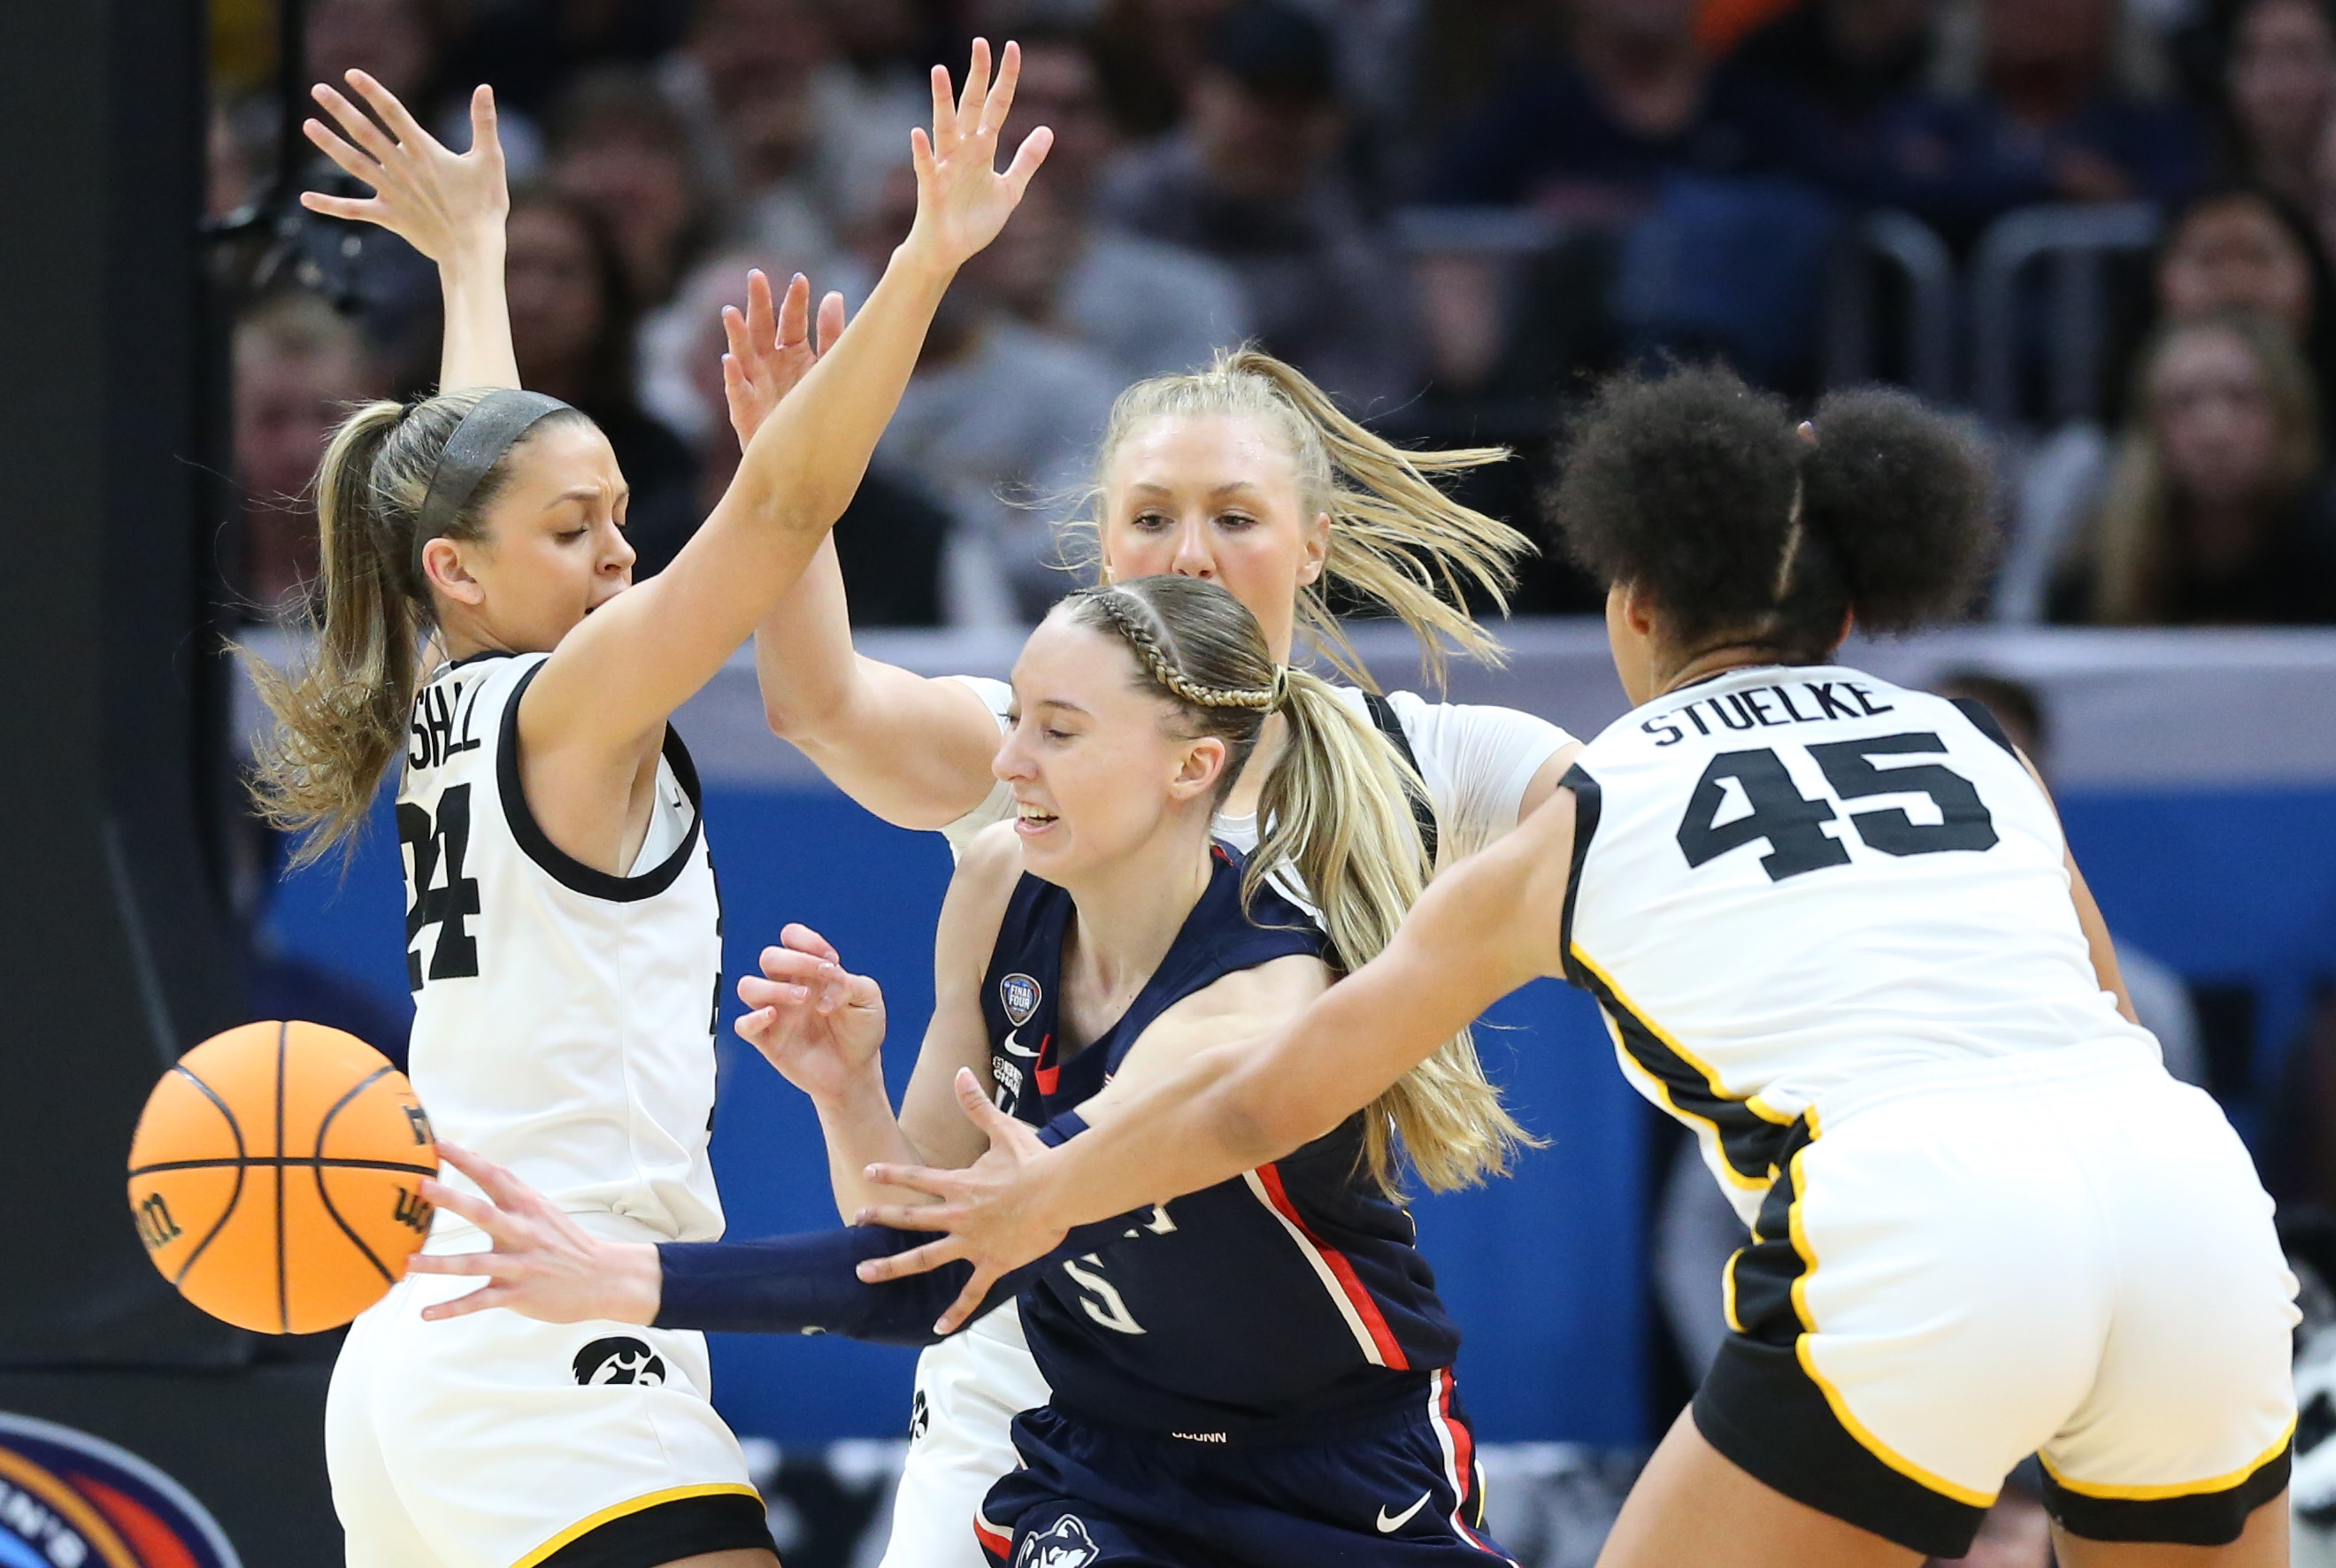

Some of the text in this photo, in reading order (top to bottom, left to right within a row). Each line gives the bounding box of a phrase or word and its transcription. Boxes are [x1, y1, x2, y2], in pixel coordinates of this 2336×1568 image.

[1641, 682, 1894, 747] STUELKE
[1676, 732, 2000, 882] 45
[1009, 994, 1030, 1010] FOUR
[1010, 984, 1031, 998] FINAL
